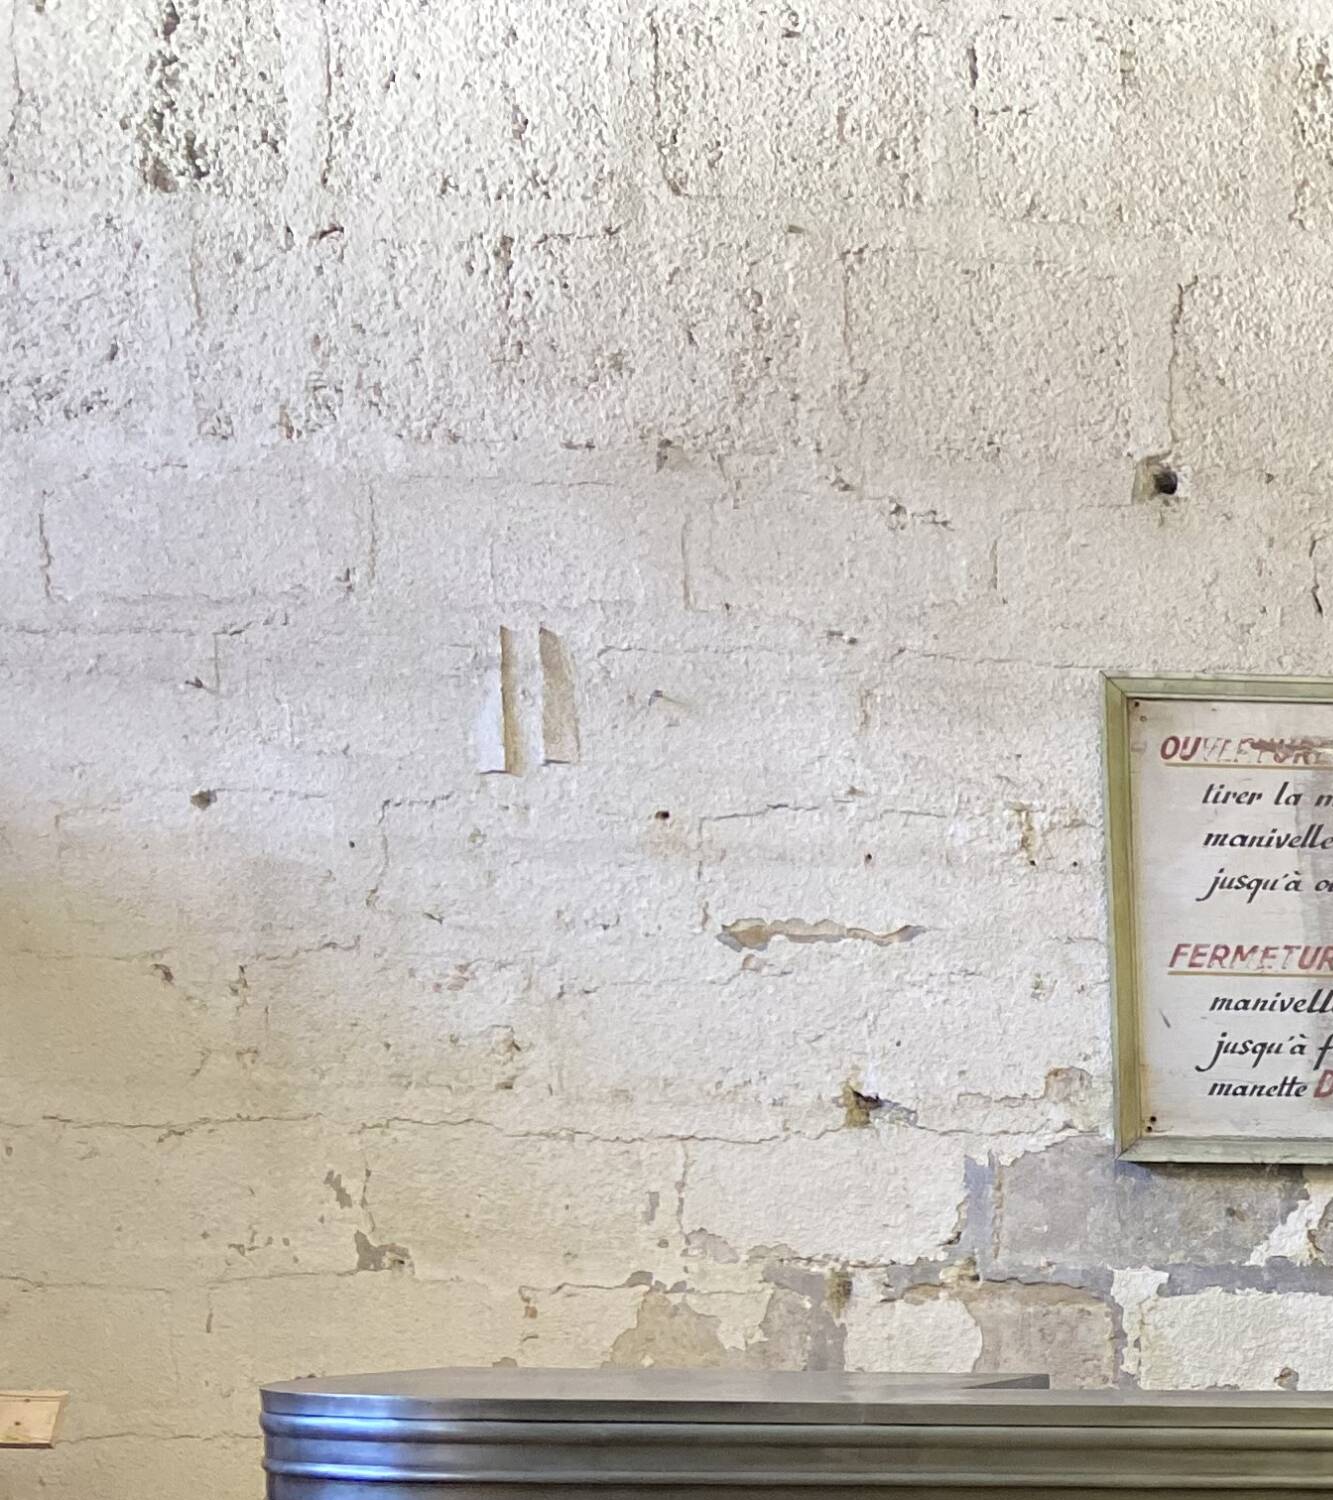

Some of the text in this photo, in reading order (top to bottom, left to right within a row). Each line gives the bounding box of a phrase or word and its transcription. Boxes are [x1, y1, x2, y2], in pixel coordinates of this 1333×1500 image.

[1201, 783, 1264, 806] tirer
[1273, 781, 1304, 807] la
[1195, 867, 1305, 904] jusqu'à
[1195, 1031, 1307, 1072] jusqu'à
[1208, 1075, 1309, 1098] manette
